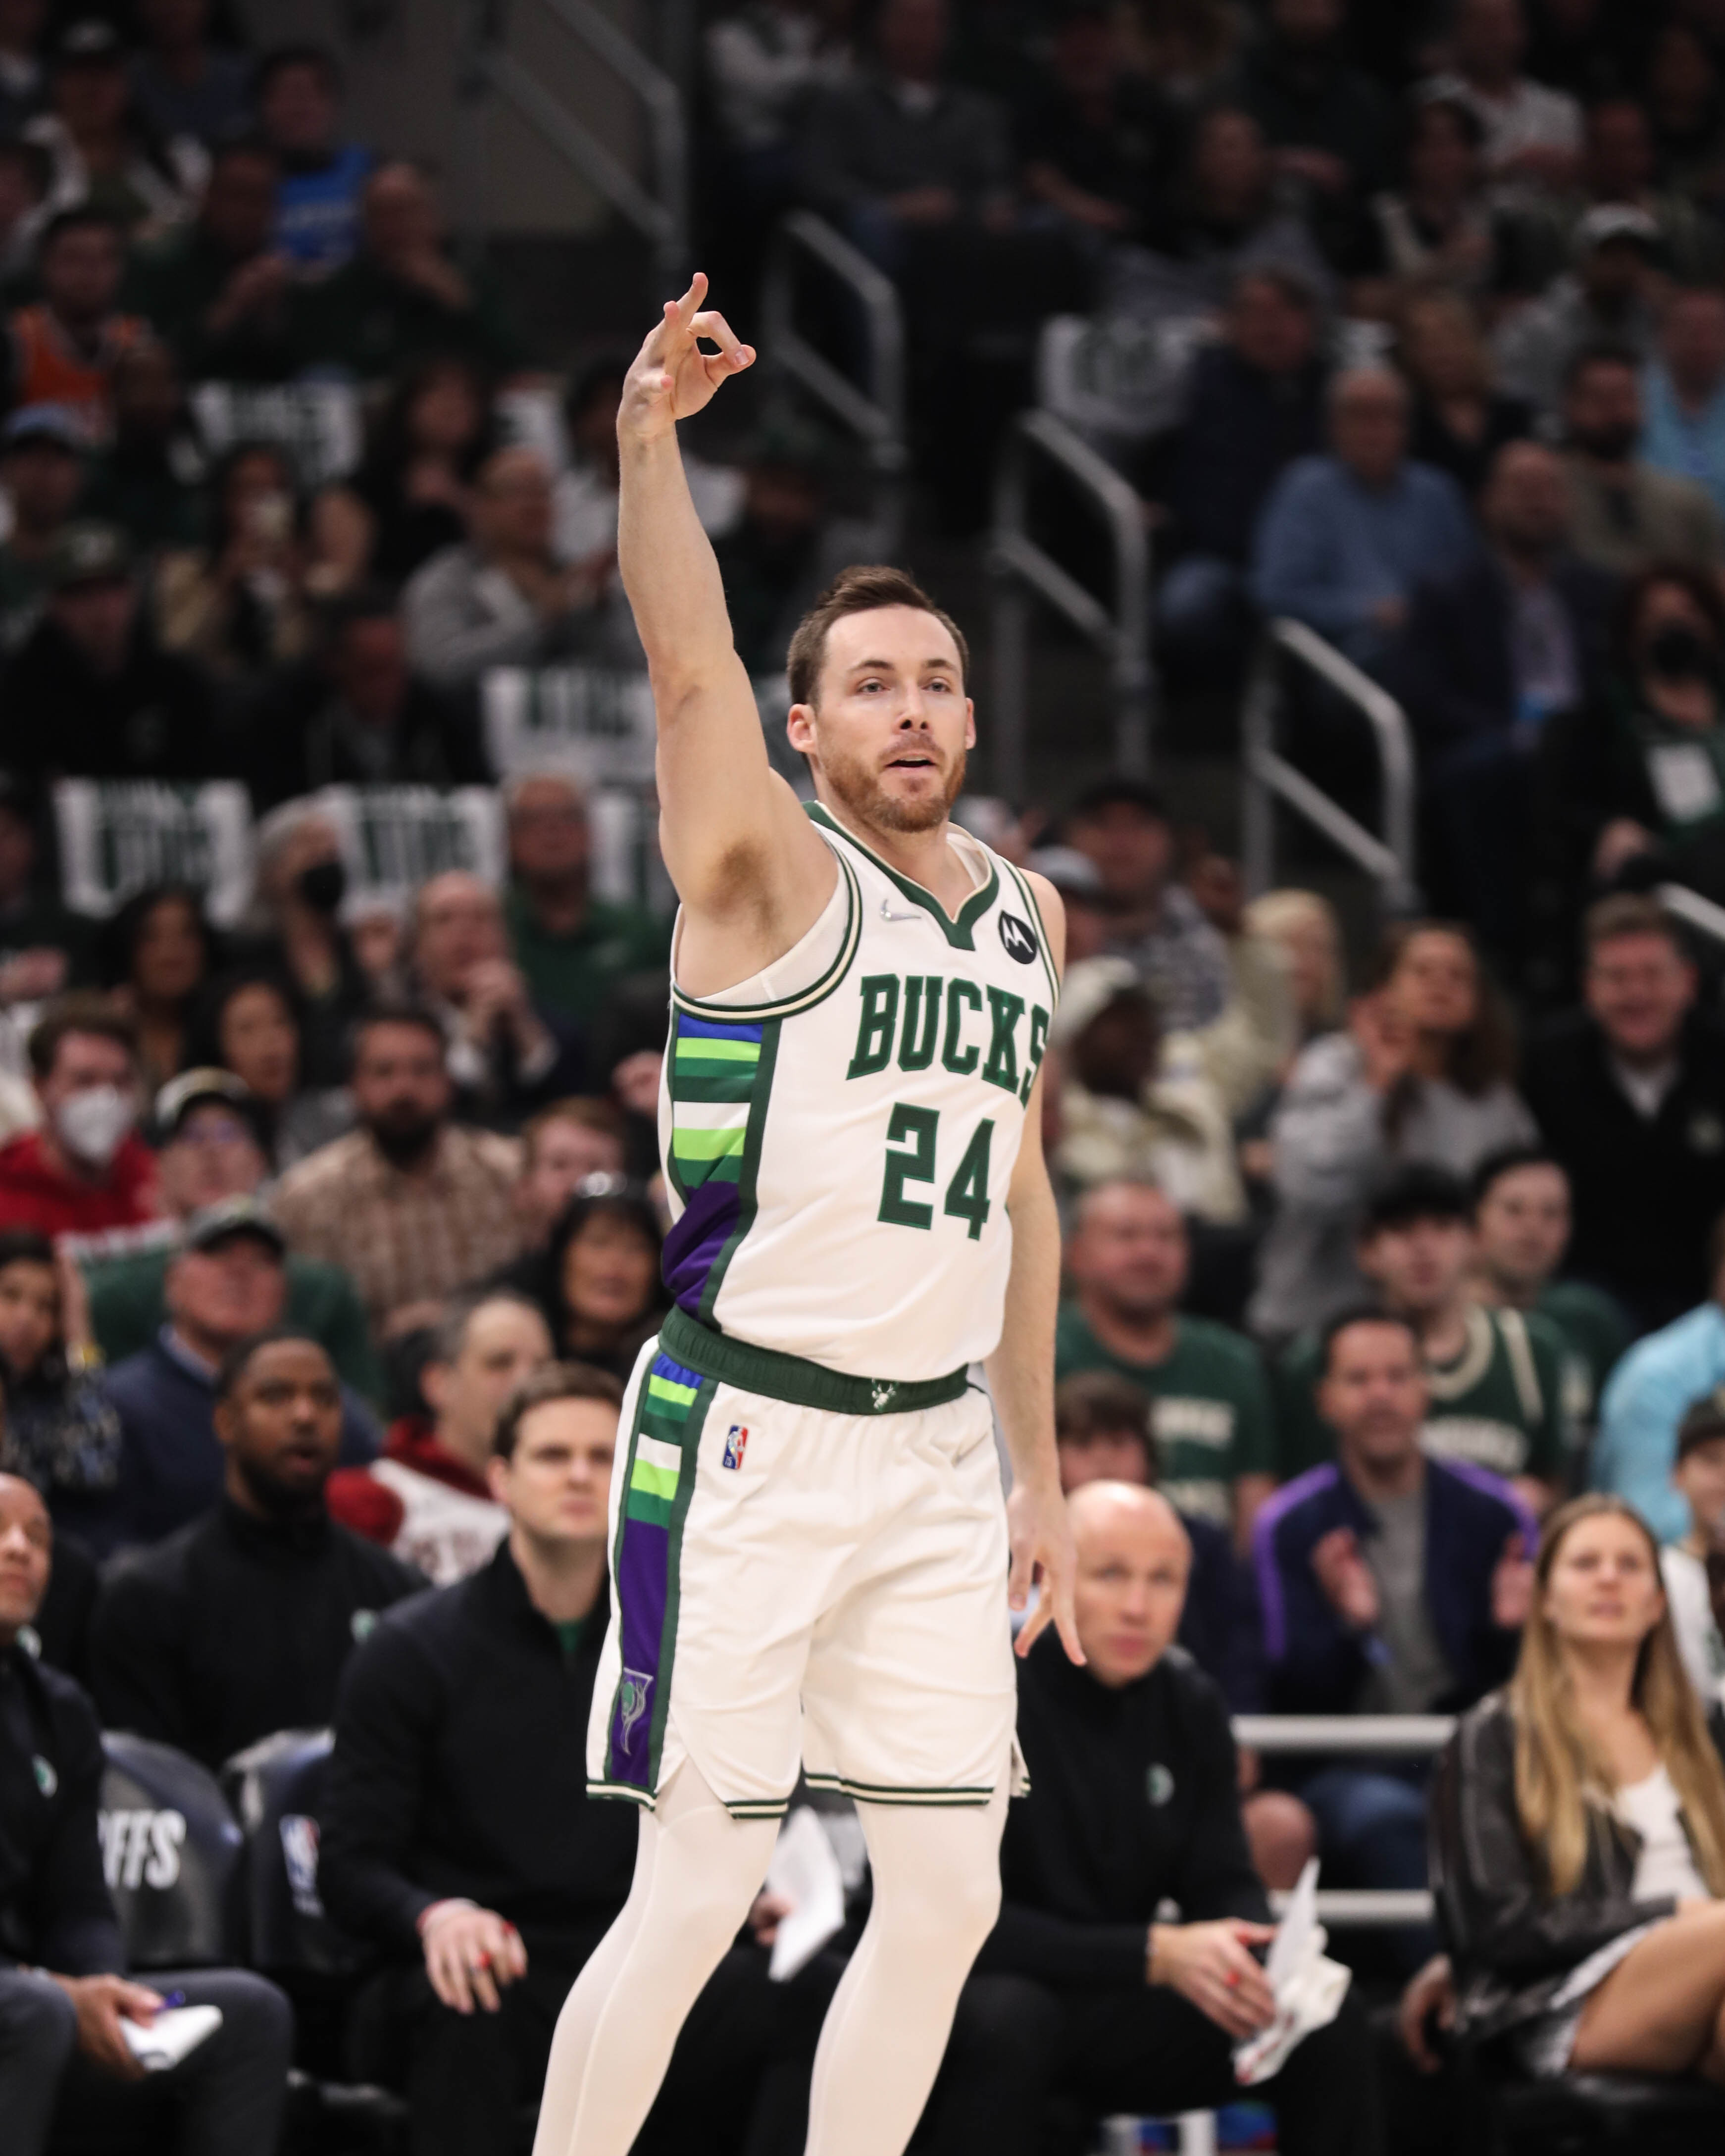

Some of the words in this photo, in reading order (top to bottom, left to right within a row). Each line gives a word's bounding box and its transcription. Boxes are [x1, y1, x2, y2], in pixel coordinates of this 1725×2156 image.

[846, 973, 1049, 1110] BUCKS
[877, 1102, 996, 1241] 24
[97, 1809, 187, 1890] FFS
